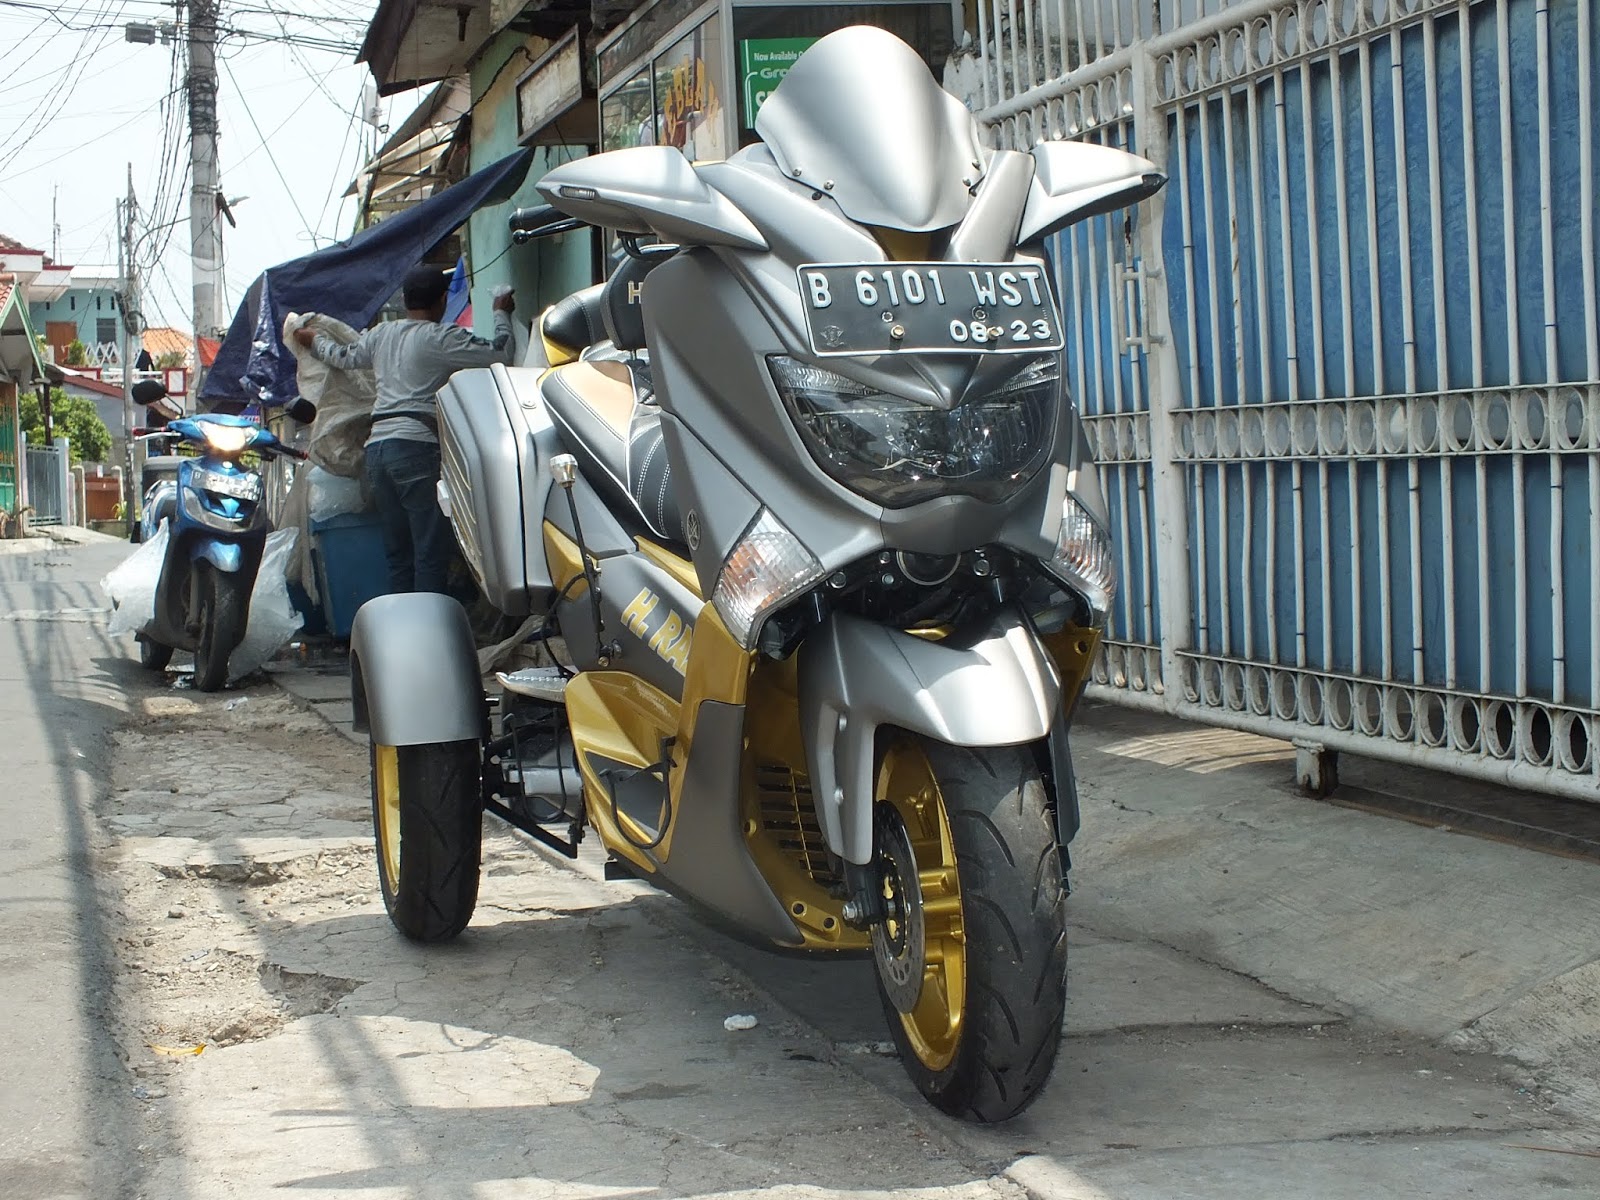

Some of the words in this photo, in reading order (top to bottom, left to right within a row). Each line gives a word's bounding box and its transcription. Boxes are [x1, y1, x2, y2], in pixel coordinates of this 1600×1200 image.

[754, 52, 768, 60] Now
[770, 51, 797, 60] Available
[807, 272, 832, 308] B
[855, 269, 946, 306] 6101
[968, 271, 1041, 306] WST
[648, 609, 692, 678] RA
